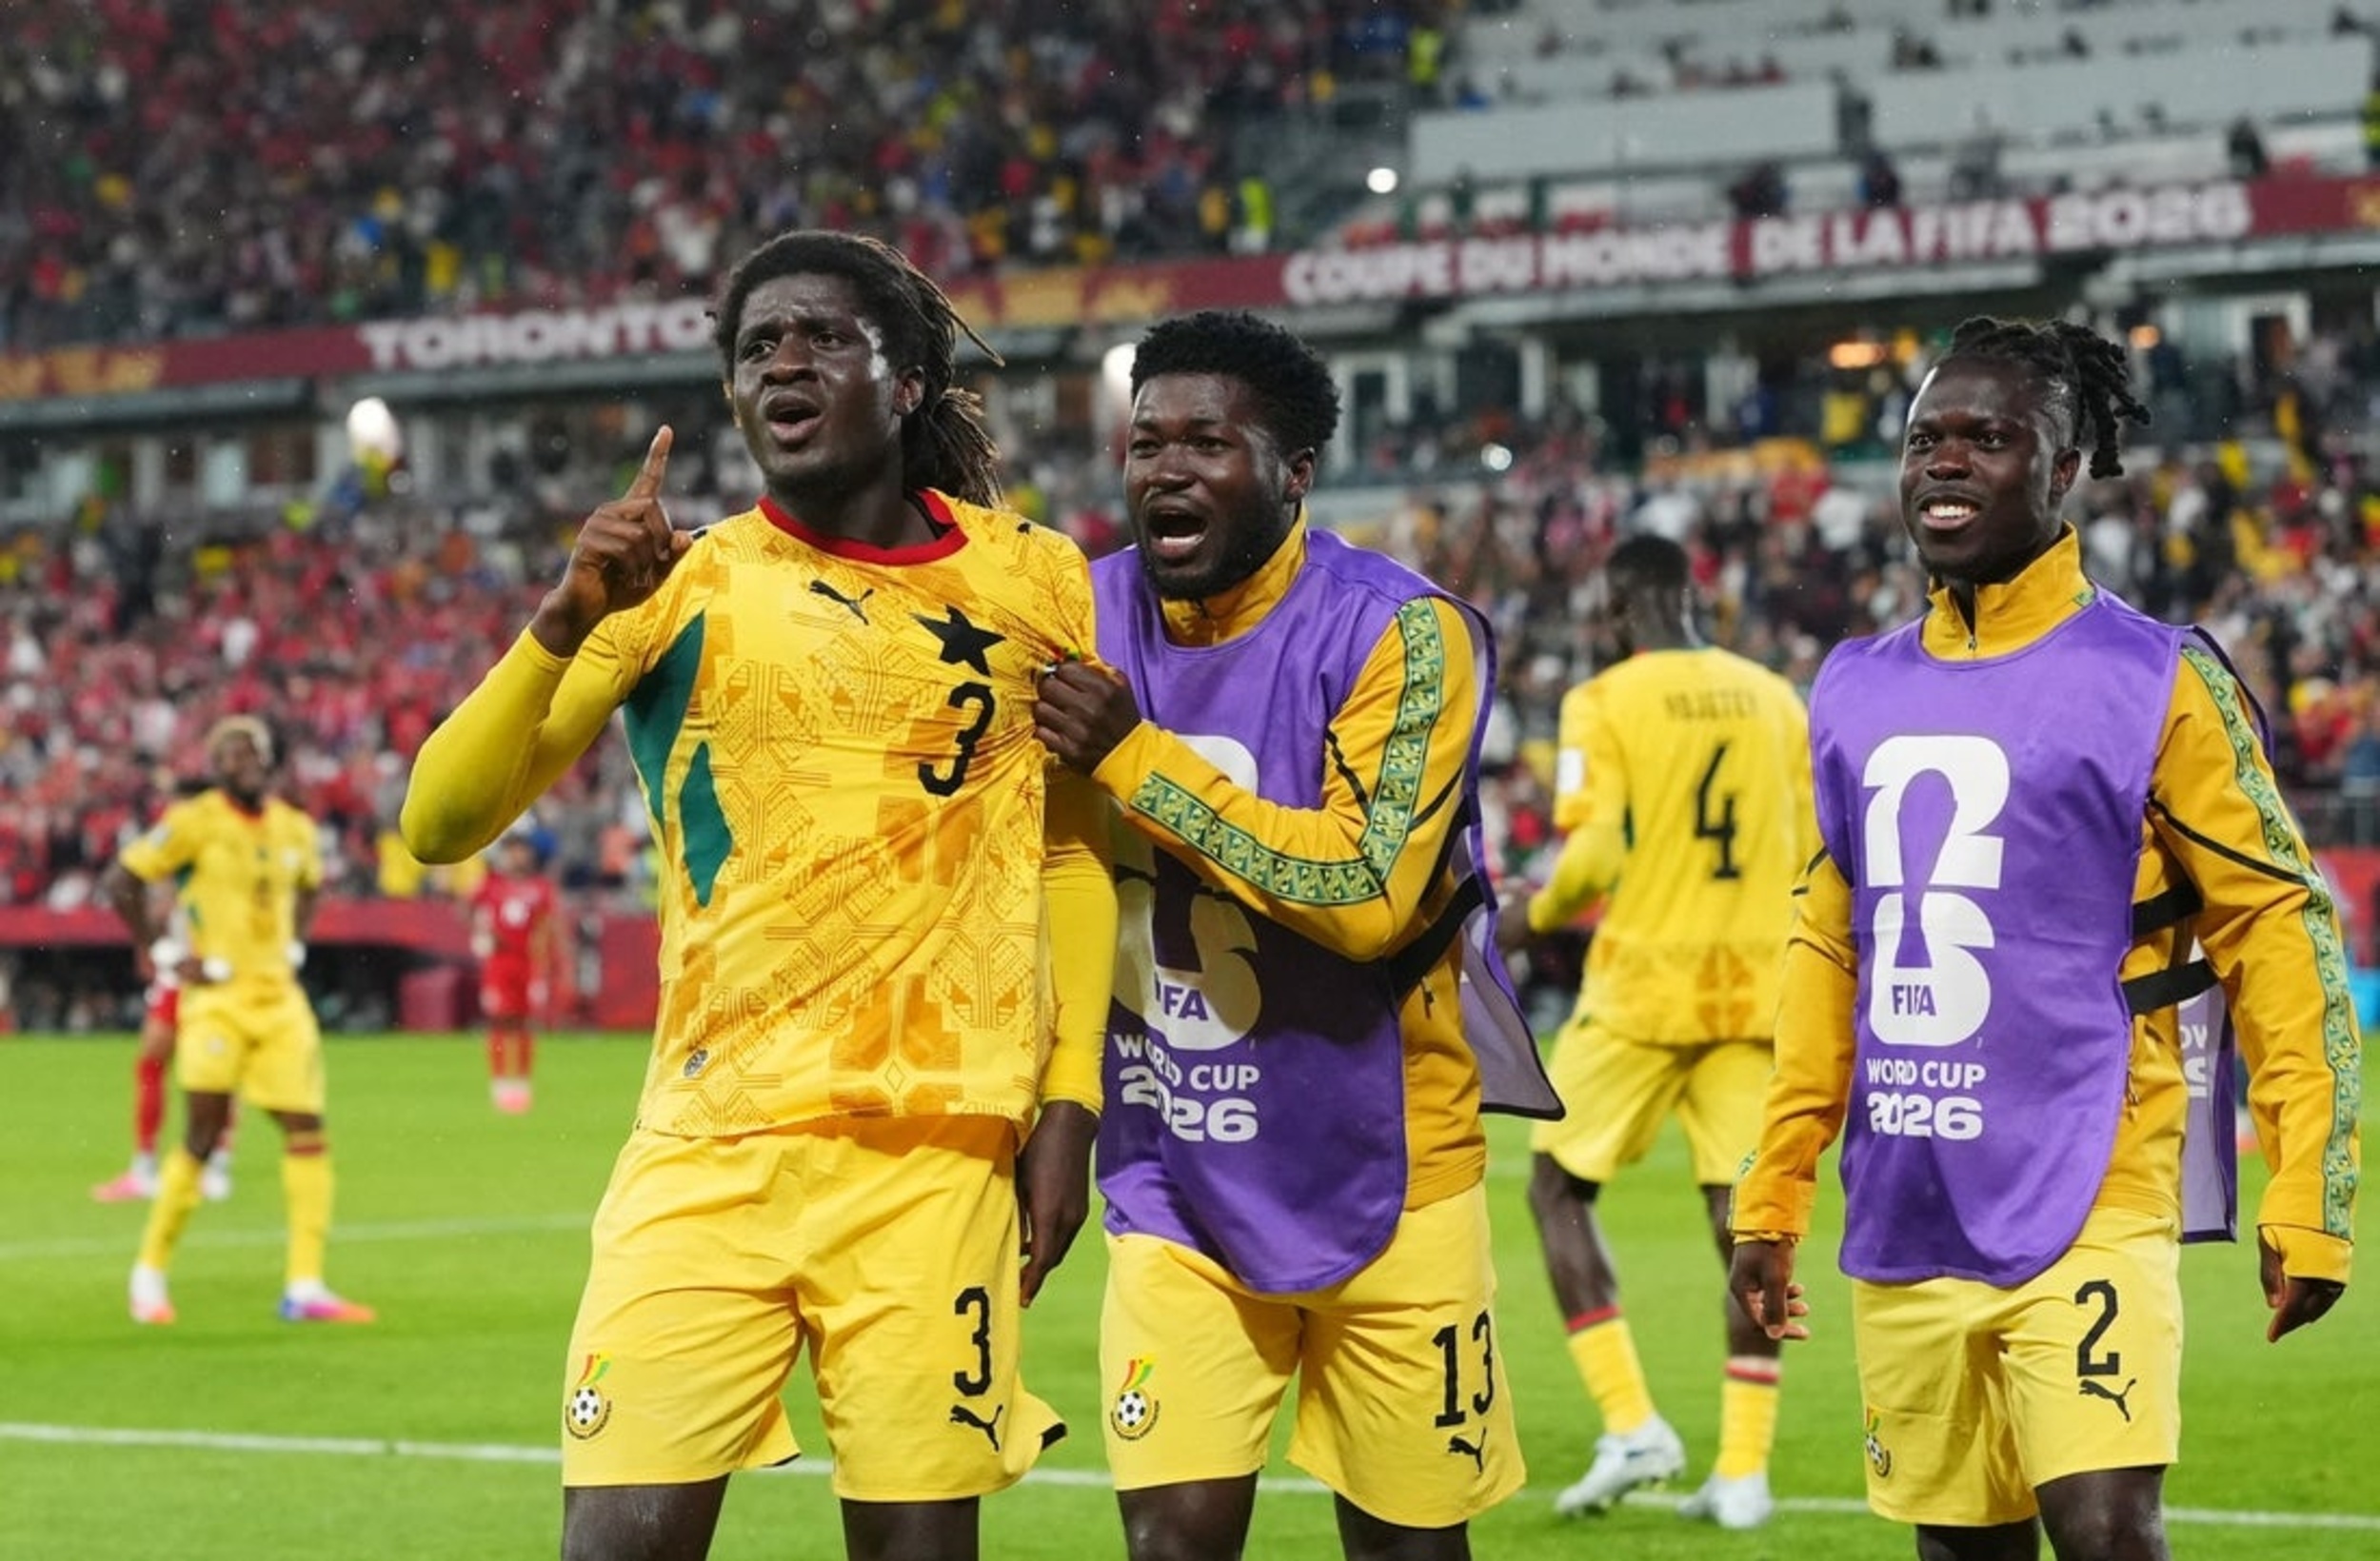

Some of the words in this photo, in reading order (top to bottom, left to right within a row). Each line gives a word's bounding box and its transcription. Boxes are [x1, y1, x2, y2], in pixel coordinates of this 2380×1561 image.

[1282, 240, 1452, 306] COUPE
[1458, 238, 1535, 295] DU
[1542, 222, 1733, 292] MONDE
[1752, 214, 1823, 277] DE
[1830, 207, 1907, 267] LA
[1910, 197, 2038, 262] FIFA
[2046, 180, 2252, 250] 2026
[360, 297, 717, 371] TORONTO
[917, 682, 996, 797] 3
[1695, 738, 1741, 880] 4
[1154, 971, 1209, 1021] IFA
[1119, 1064, 1259, 1142] 2026
[1189, 1064, 1260, 1092] CUP
[1866, 1091, 1984, 1140] 2026
[1921, 1060, 1987, 1090] CUP
[953, 1286, 991, 1397] 3
[1432, 1308, 1494, 1428] 13
[2074, 1278, 2120, 1377] 2
